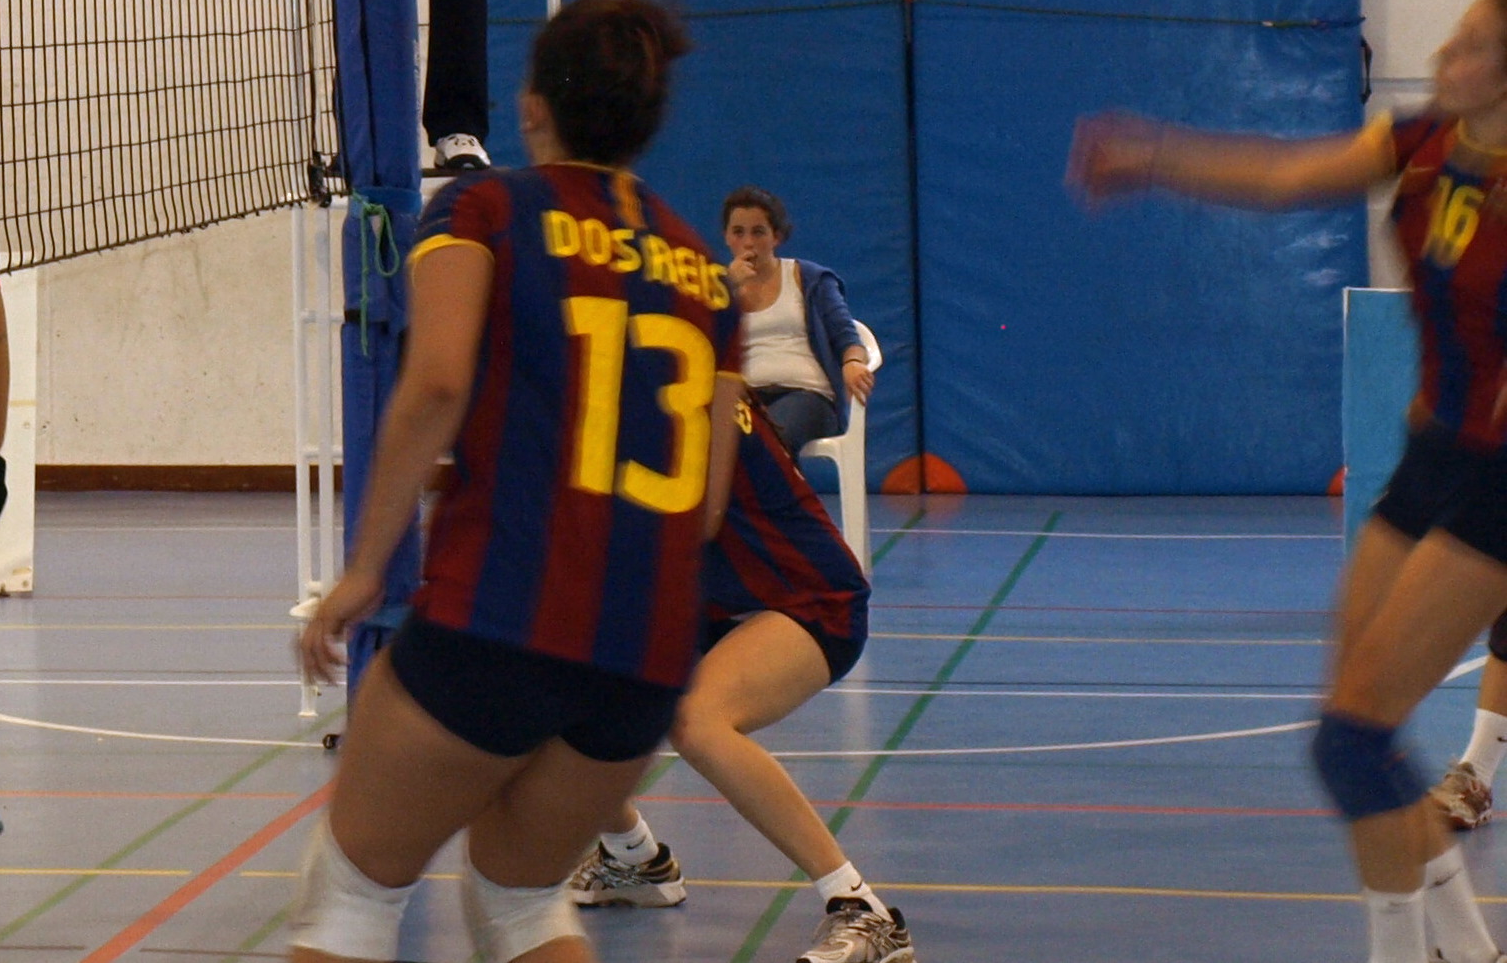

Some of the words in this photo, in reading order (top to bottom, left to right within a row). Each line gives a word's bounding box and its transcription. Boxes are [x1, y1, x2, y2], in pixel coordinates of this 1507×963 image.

[541, 208, 642, 274] DOS
[639, 233, 732, 311] REIS
[1421, 174, 1485, 268] 16
[561, 294, 717, 514] 13
